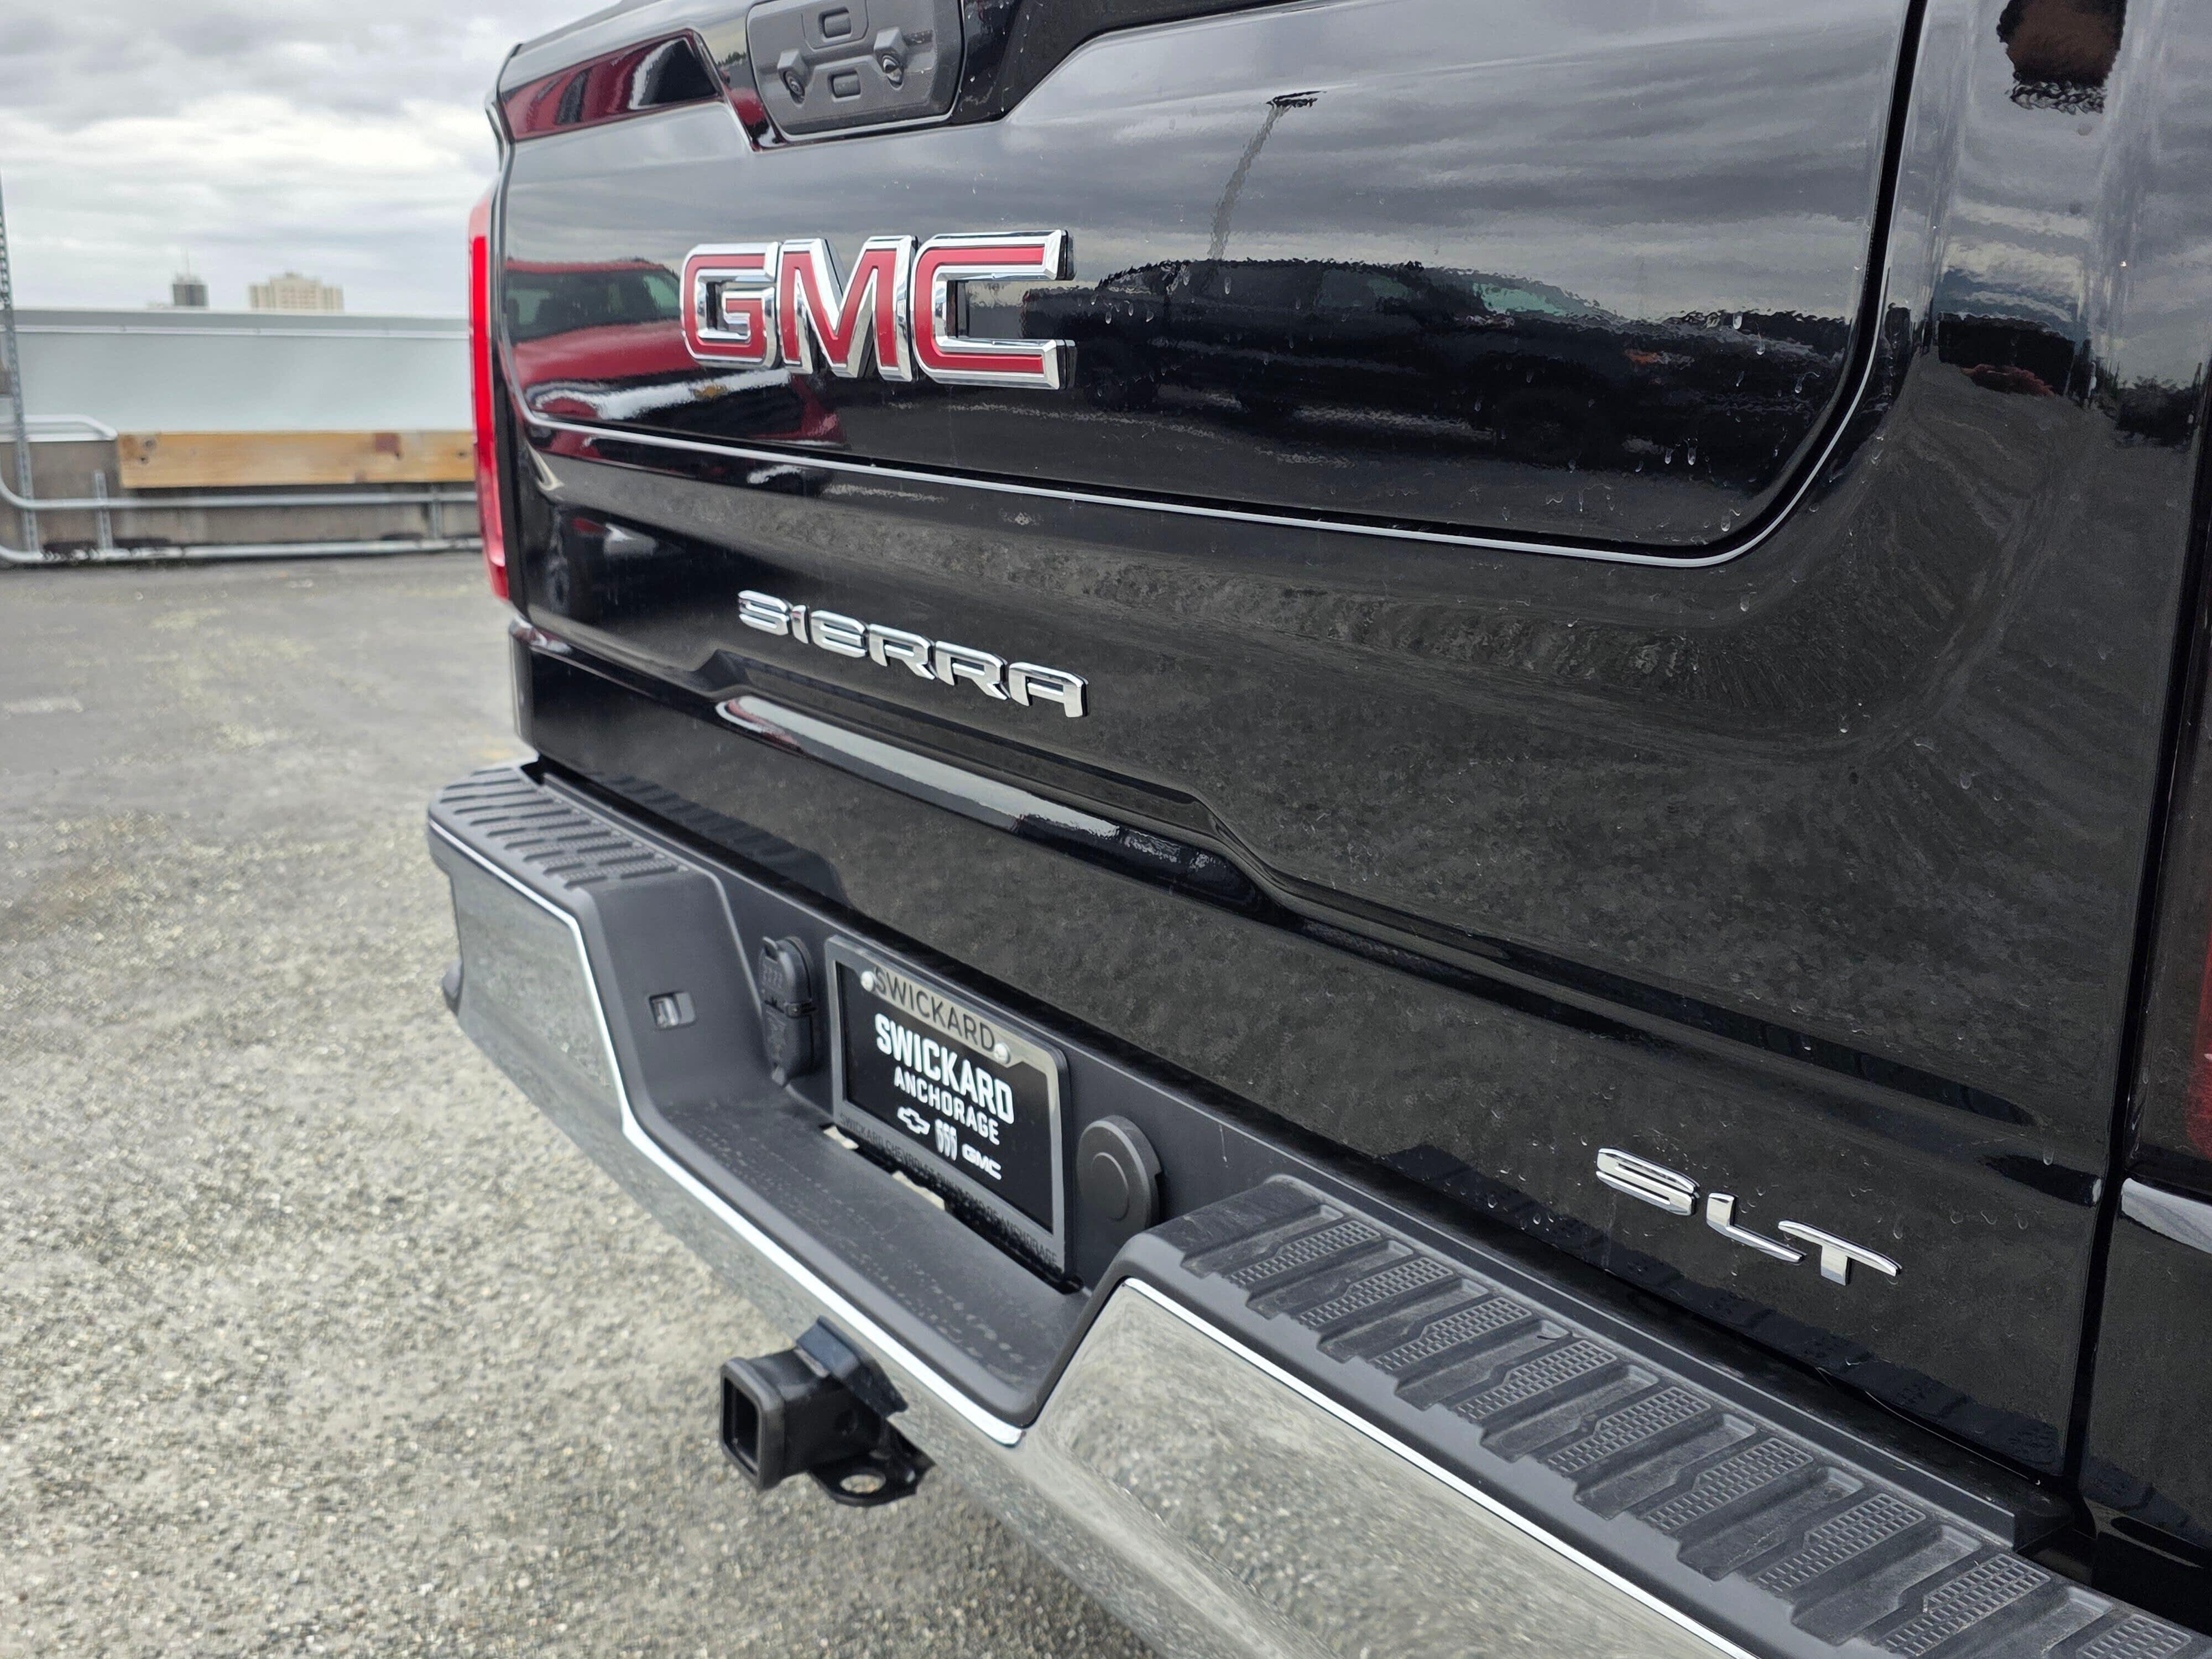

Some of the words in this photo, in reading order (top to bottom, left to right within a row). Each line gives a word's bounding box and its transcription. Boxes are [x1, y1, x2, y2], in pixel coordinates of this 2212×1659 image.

[680, 229, 1074, 390] GMC
[738, 589, 1088, 718] SIERRA
[873, 966, 995, 1052] SWICKARD
[874, 1013, 1014, 1125] SWICKARD
[894, 1066, 1000, 1145] ANCHORAGE
[961, 1142, 1001, 1181] GMC
[1596, 1147, 1901, 1286] SLT
